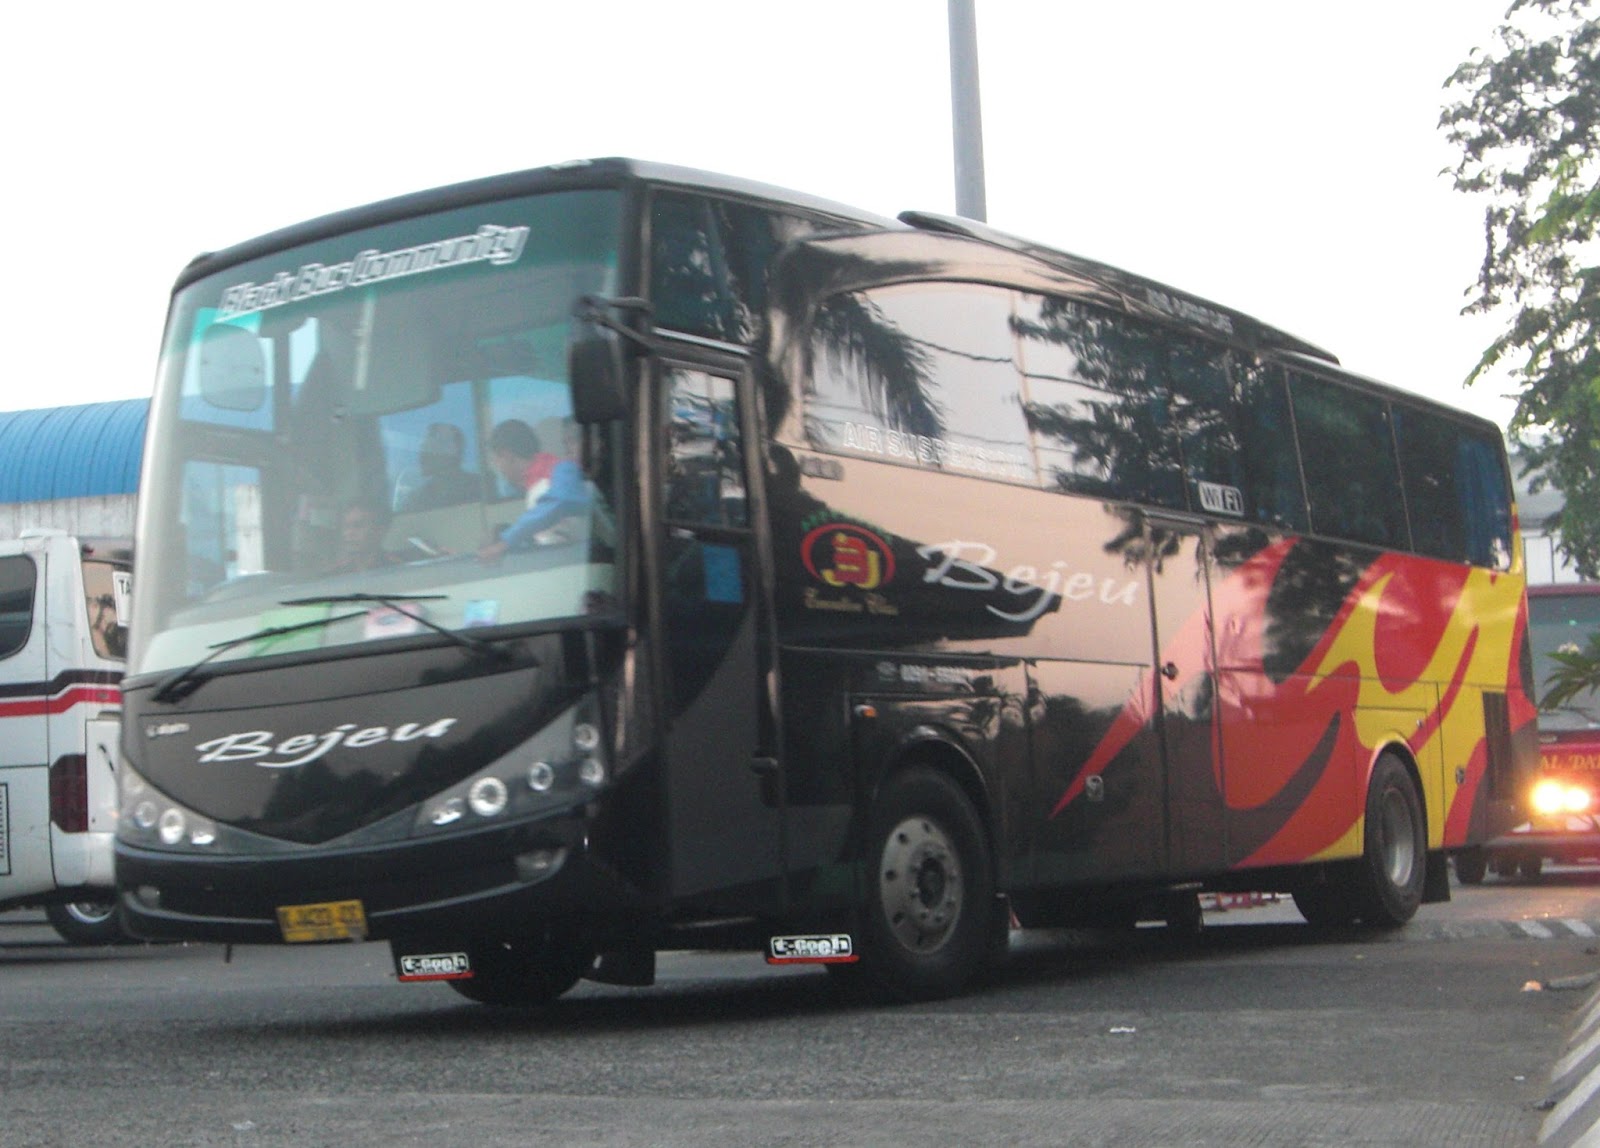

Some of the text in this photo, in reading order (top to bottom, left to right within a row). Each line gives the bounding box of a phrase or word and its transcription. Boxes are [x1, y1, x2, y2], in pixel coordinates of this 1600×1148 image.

[842, 420, 884, 456] AIR
[916, 539, 1141, 623] Bejeu
[195, 717, 459, 769] Bejeu
